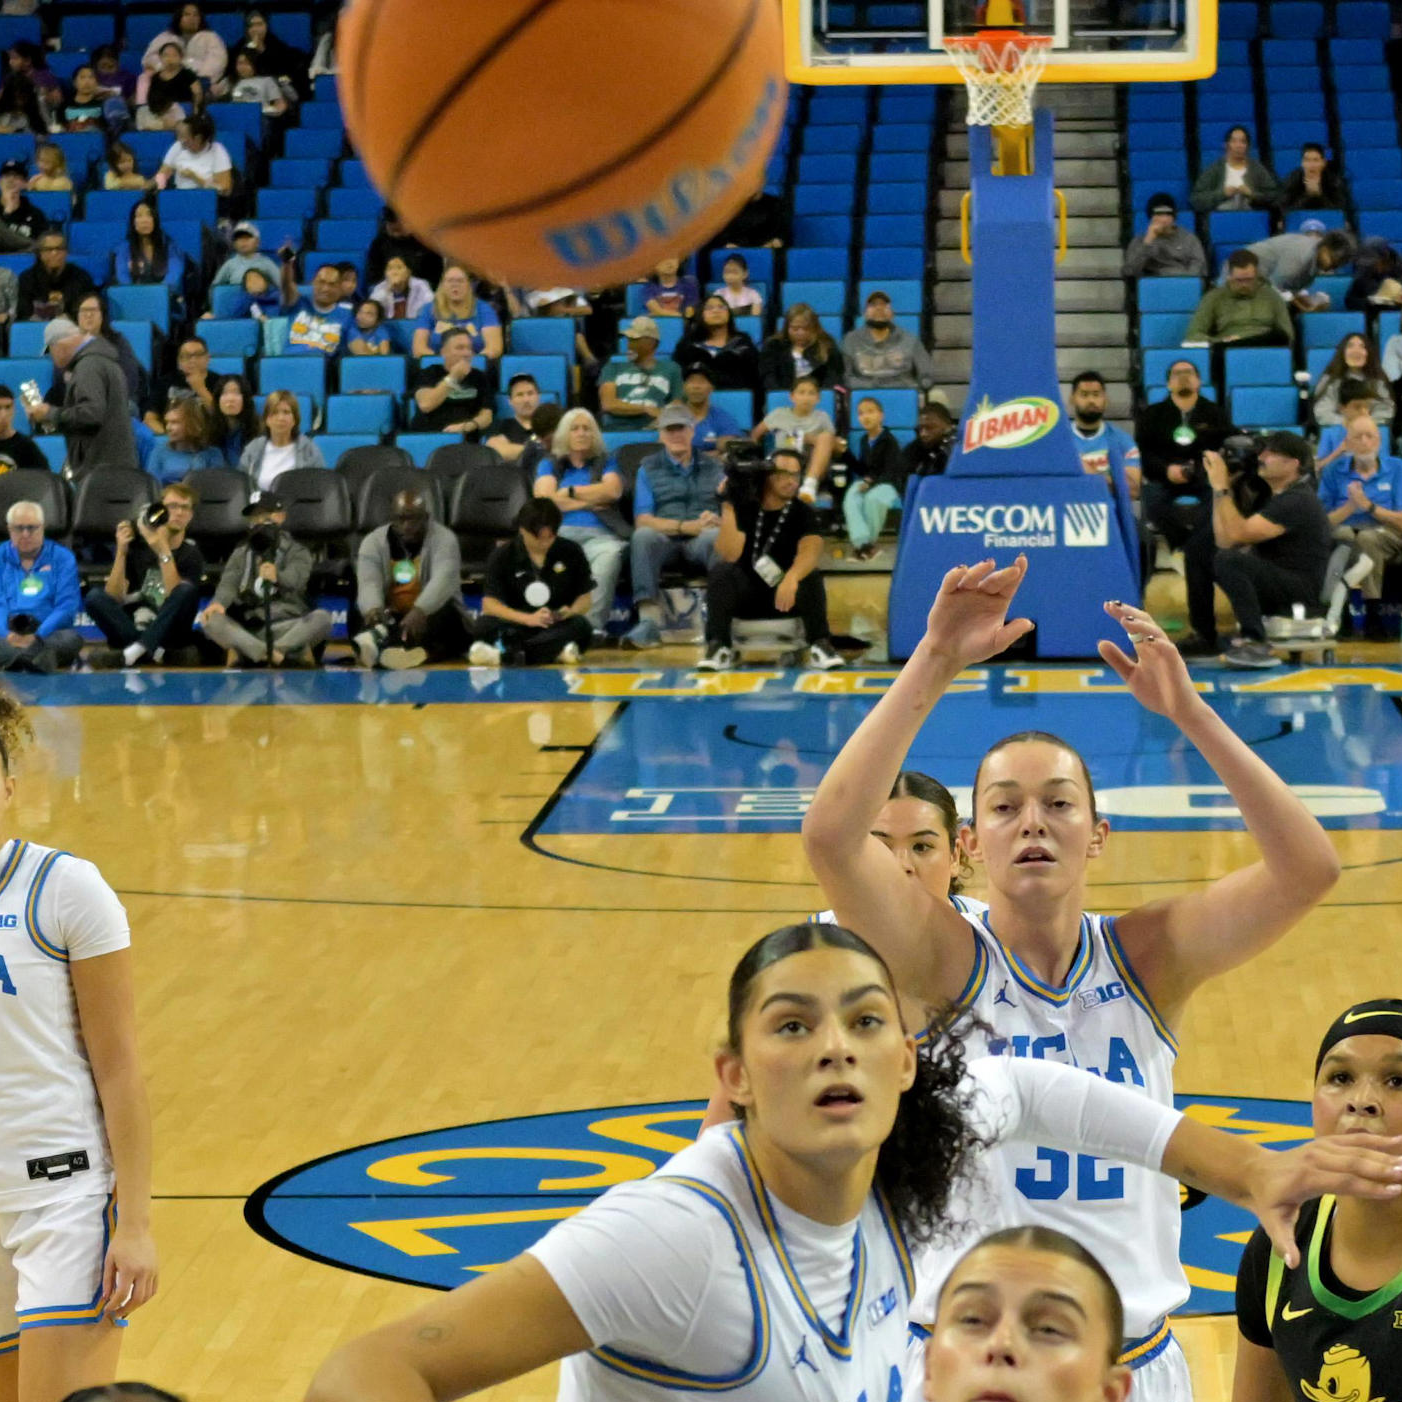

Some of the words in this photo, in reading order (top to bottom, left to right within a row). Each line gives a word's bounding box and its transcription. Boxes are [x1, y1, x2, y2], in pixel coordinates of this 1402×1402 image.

[964, 403, 1050, 453] LIBMAN
[919, 504, 1056, 534] WESCOM
[984, 533, 1056, 548] Financial
